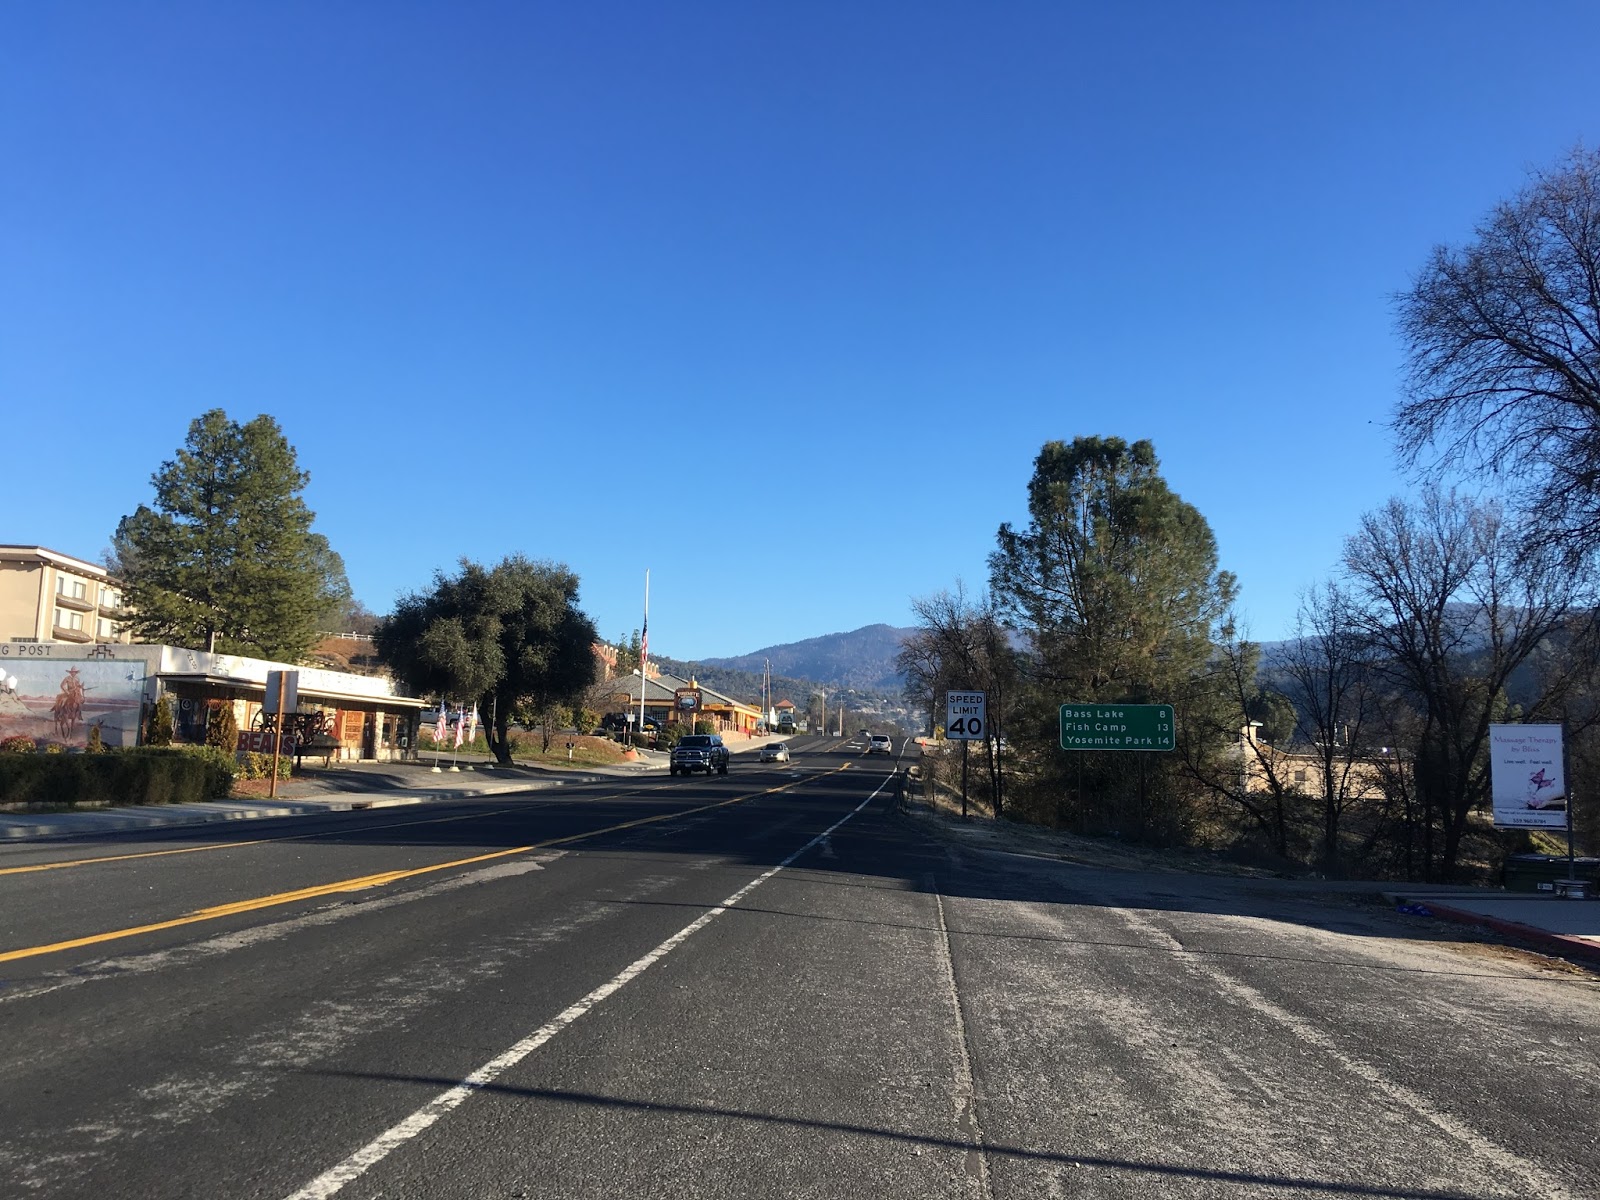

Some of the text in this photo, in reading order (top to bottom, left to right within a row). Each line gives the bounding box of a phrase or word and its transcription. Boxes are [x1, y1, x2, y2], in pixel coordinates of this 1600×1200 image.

[18, 645, 52, 656] POST
[949, 695, 983, 704] SPEED
[952, 706, 979, 715] LIMIT
[1065, 709, 1166, 719] Bass Lake 8
[949, 717, 982, 735] 40
[1065, 722, 1169, 733] Fish Camp 13
[1066, 735, 1170, 745] Yosemite Park 14
[1494, 735, 1558, 745] Massage Therapy
[1522, 745, 1541, 753] Bliss
